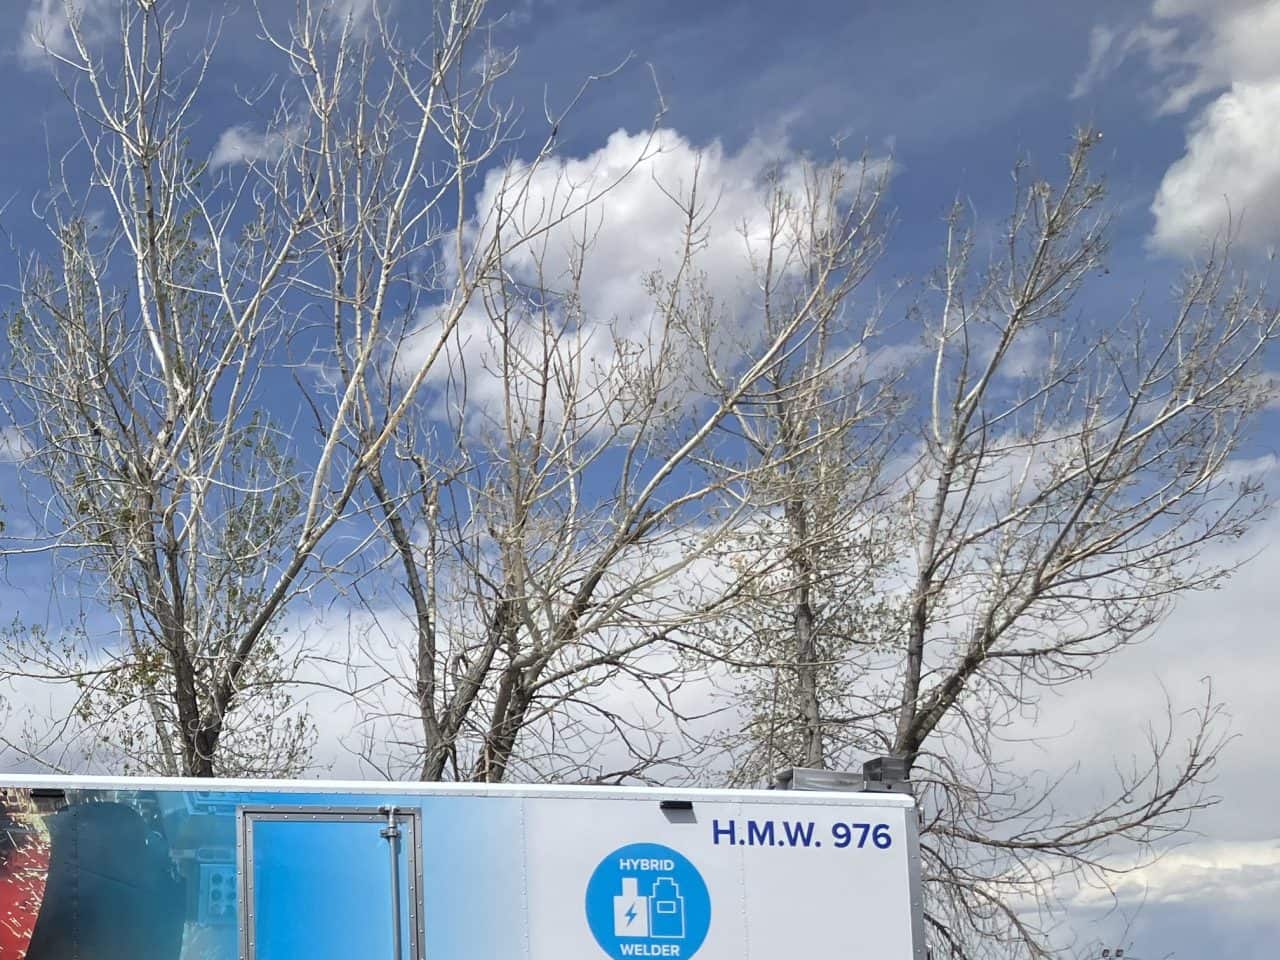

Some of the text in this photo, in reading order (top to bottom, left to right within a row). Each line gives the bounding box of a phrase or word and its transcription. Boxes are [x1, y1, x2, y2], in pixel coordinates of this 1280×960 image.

[712, 819, 892, 850] H.M.W. 976
[619, 858, 675, 871] HYBRID
[619, 943, 681, 957] WELDER
